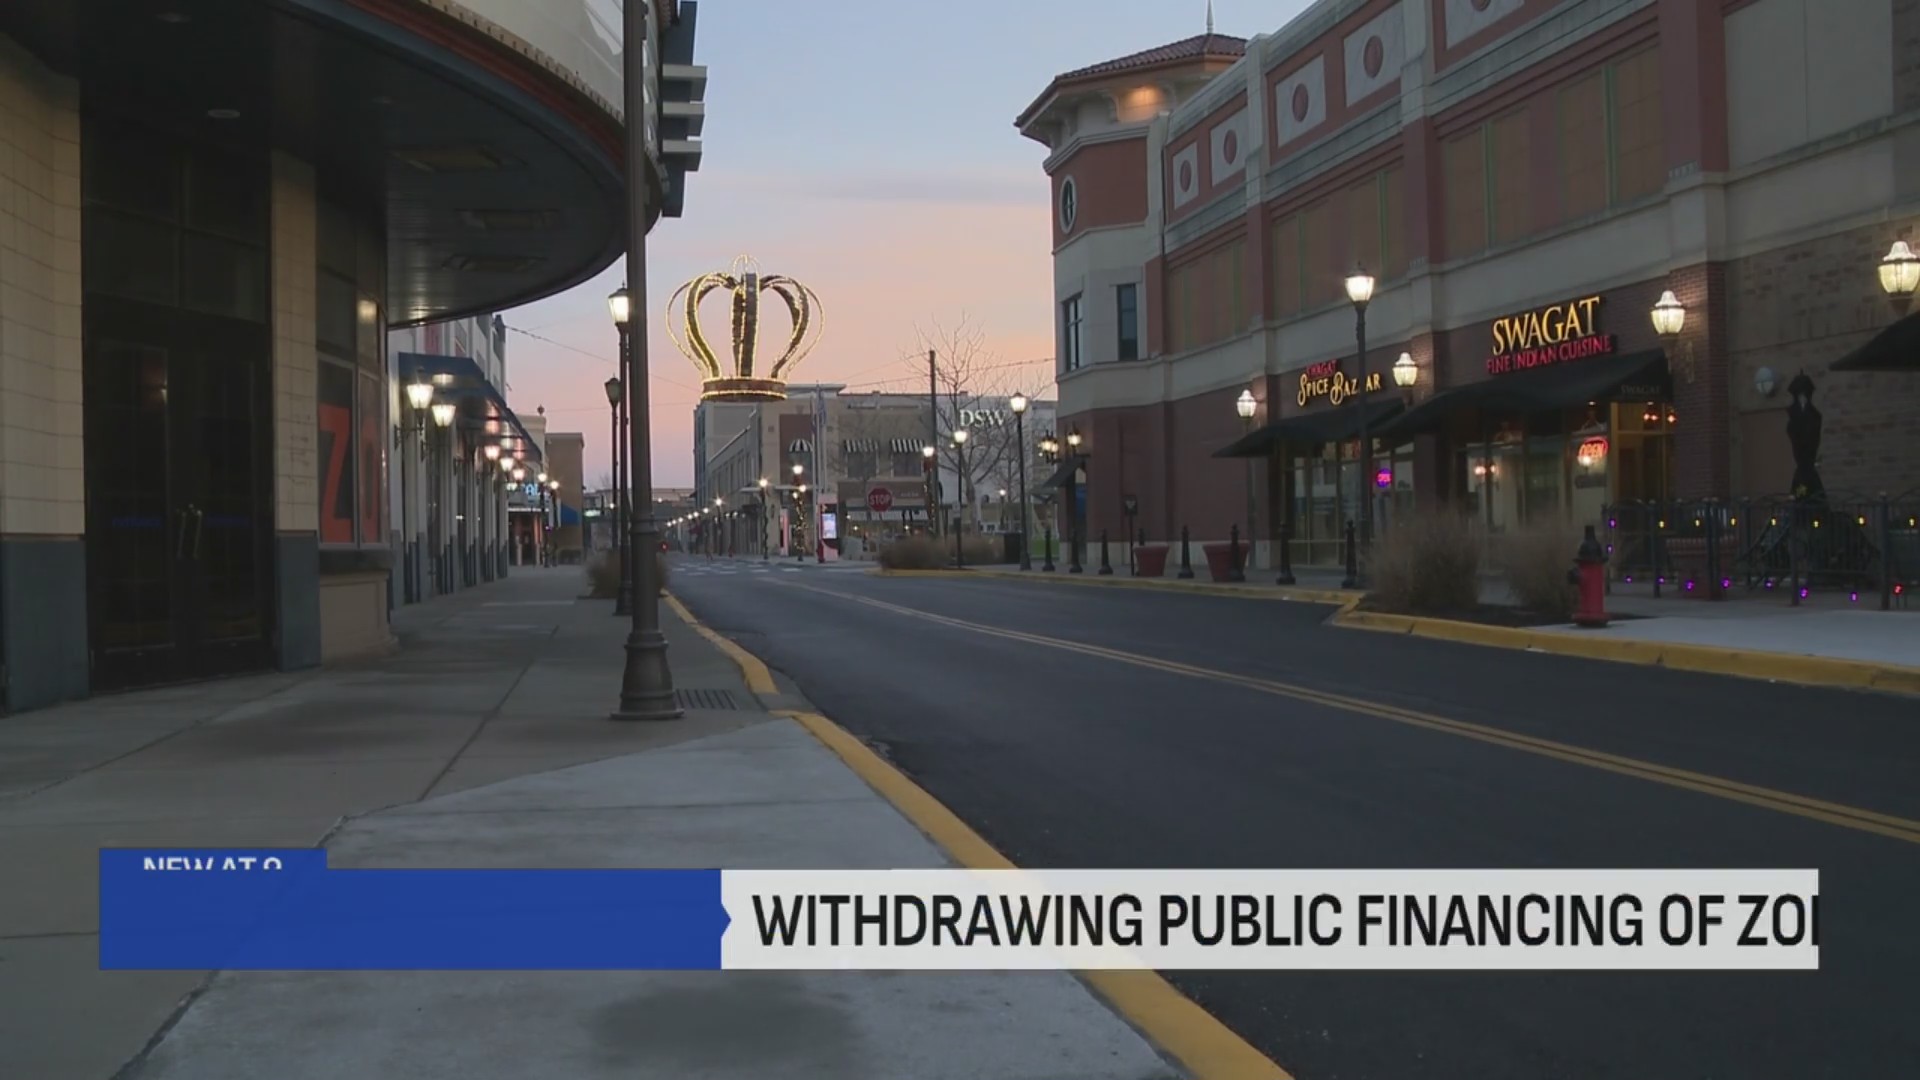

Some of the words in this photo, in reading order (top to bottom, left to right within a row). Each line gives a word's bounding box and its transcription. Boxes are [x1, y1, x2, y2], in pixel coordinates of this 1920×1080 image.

[1492, 295, 1600, 356] SWAGAT
[1486, 355, 1511, 373] FINE
[1513, 347, 1557, 369] INDIAN
[1560, 335, 1613, 361] CUISINE
[1297, 373, 1328, 406] SPICE
[1331, 371, 1381, 405] BAZAR
[960, 408, 1007, 428] DSW
[1578, 442, 1605, 461] OPEN
[870, 494, 890, 505] STOP
